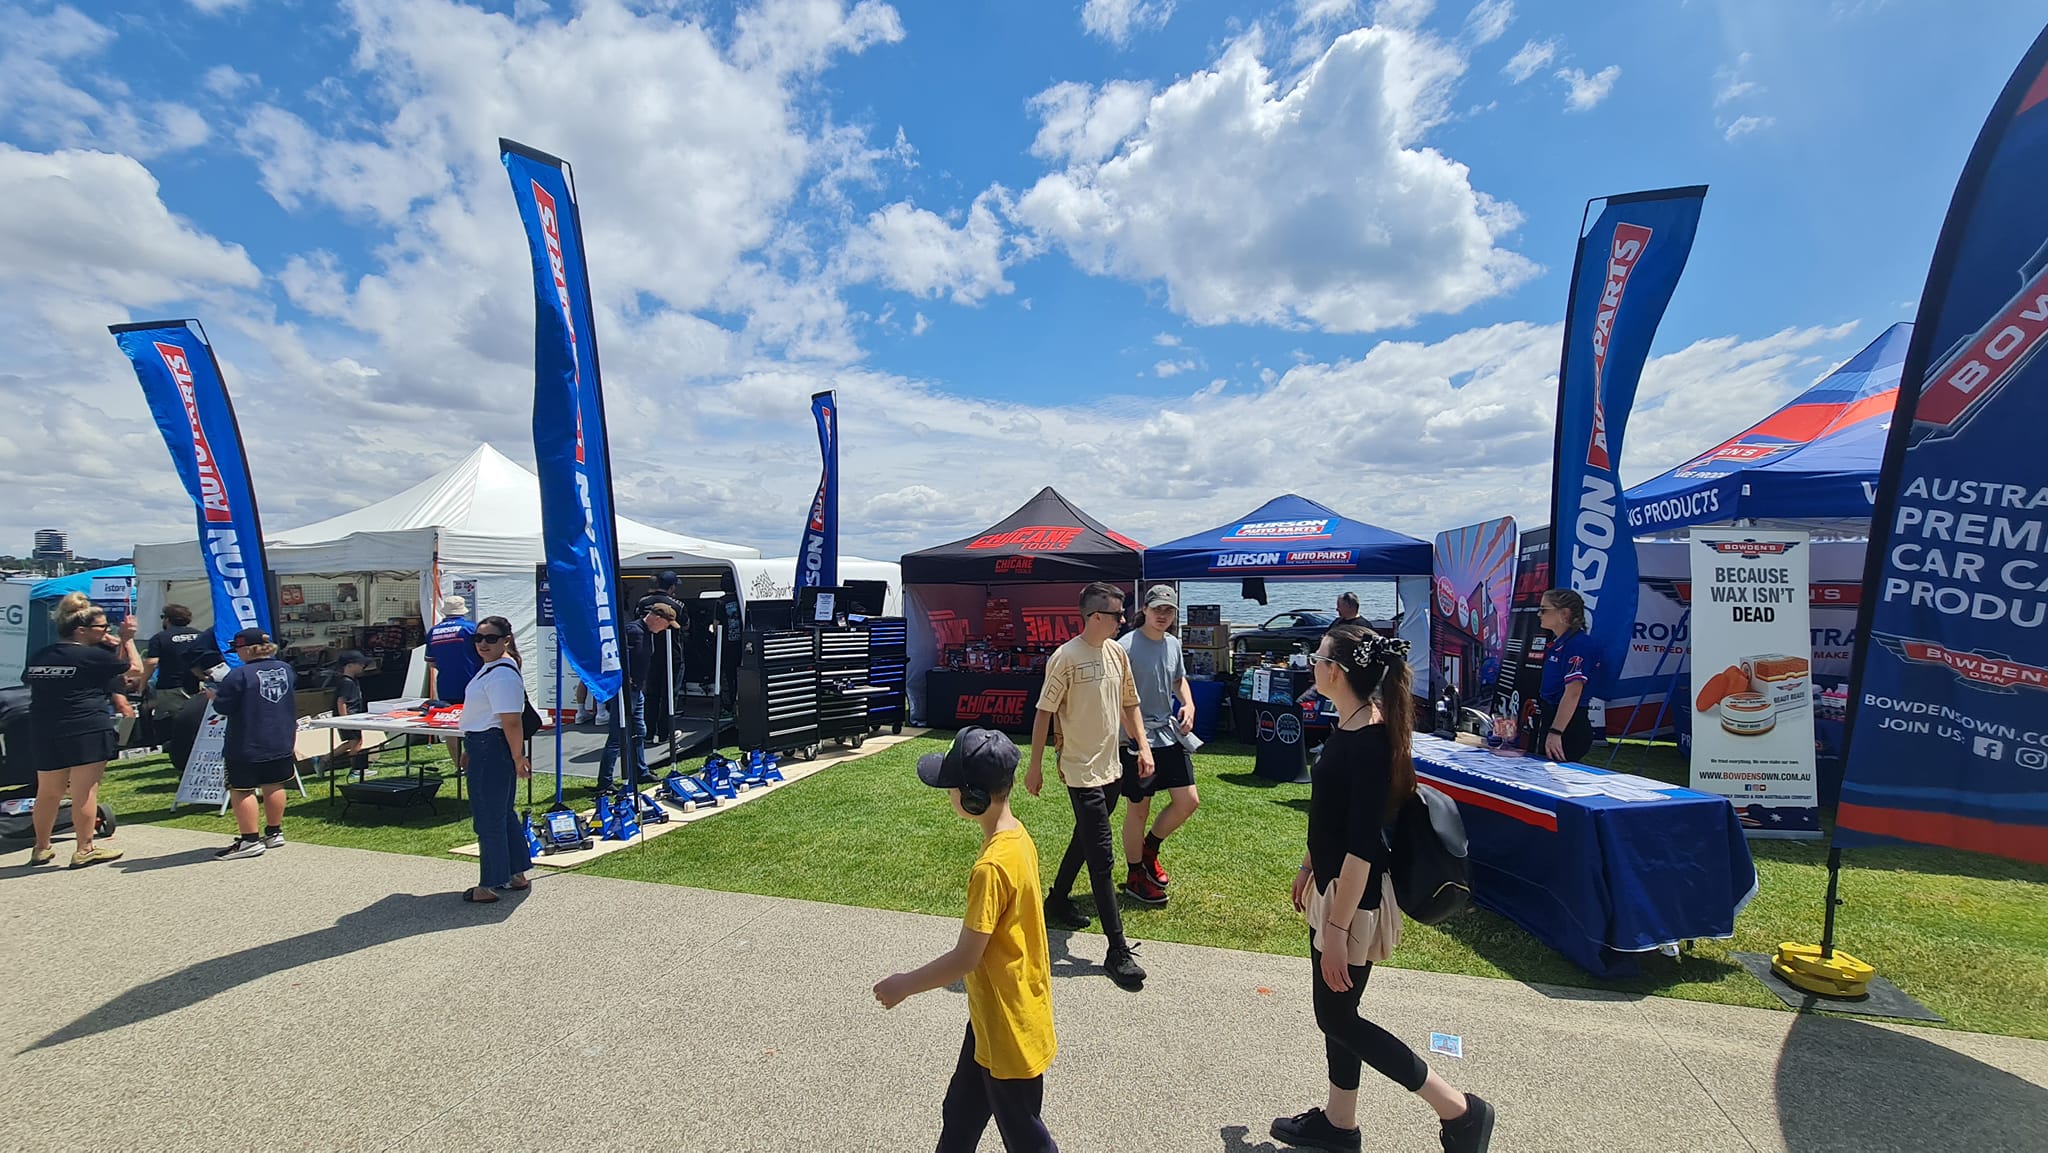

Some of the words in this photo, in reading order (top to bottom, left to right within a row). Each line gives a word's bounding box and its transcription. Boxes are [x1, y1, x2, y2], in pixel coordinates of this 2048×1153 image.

[1593, 239, 1641, 357] PARTS
[1643, 488, 1719, 524] PRODUCTS
[1241, 519, 1328, 529] BURSON
[1275, 525, 1319, 533] PARTS
[968, 527, 1084, 548] CHICANE
[1021, 542, 1069, 551] TOOLS
[1724, 542, 1777, 551] BOWDEN'S
[1216, 552, 1280, 567] BURSON
[1290, 552, 1316, 560] AUTO
[1316, 551, 1348, 560] PARTS
[1571, 474, 1616, 636] RSON
[1891, 543, 1985, 583] CAR
[995, 558, 1034, 572] CHICANE
[1715, 567, 1789, 584] BECAUSE
[104, 583, 126, 593] istore
[1710, 586, 1748, 603] WAX
[1753, 587, 1795, 603] ISN'T
[1883, 577, 2047, 628] PRODU
[1732, 606, 1775, 622] DEAD
[1632, 644, 1650, 652] WE
[1653, 645, 1683, 654] TRED
[1813, 650, 1849, 659] MAKE
[1969, 671, 2005, 684] OWN
[957, 694, 1028, 715] CHICANE
[991, 714, 1022, 725] TOOLS
[1878, 717, 1930, 734] JOIN
[1937, 725, 1965, 744] US:
[1699, 771, 1811, 781] WWW.BOWDENSOWN.COM.AU
